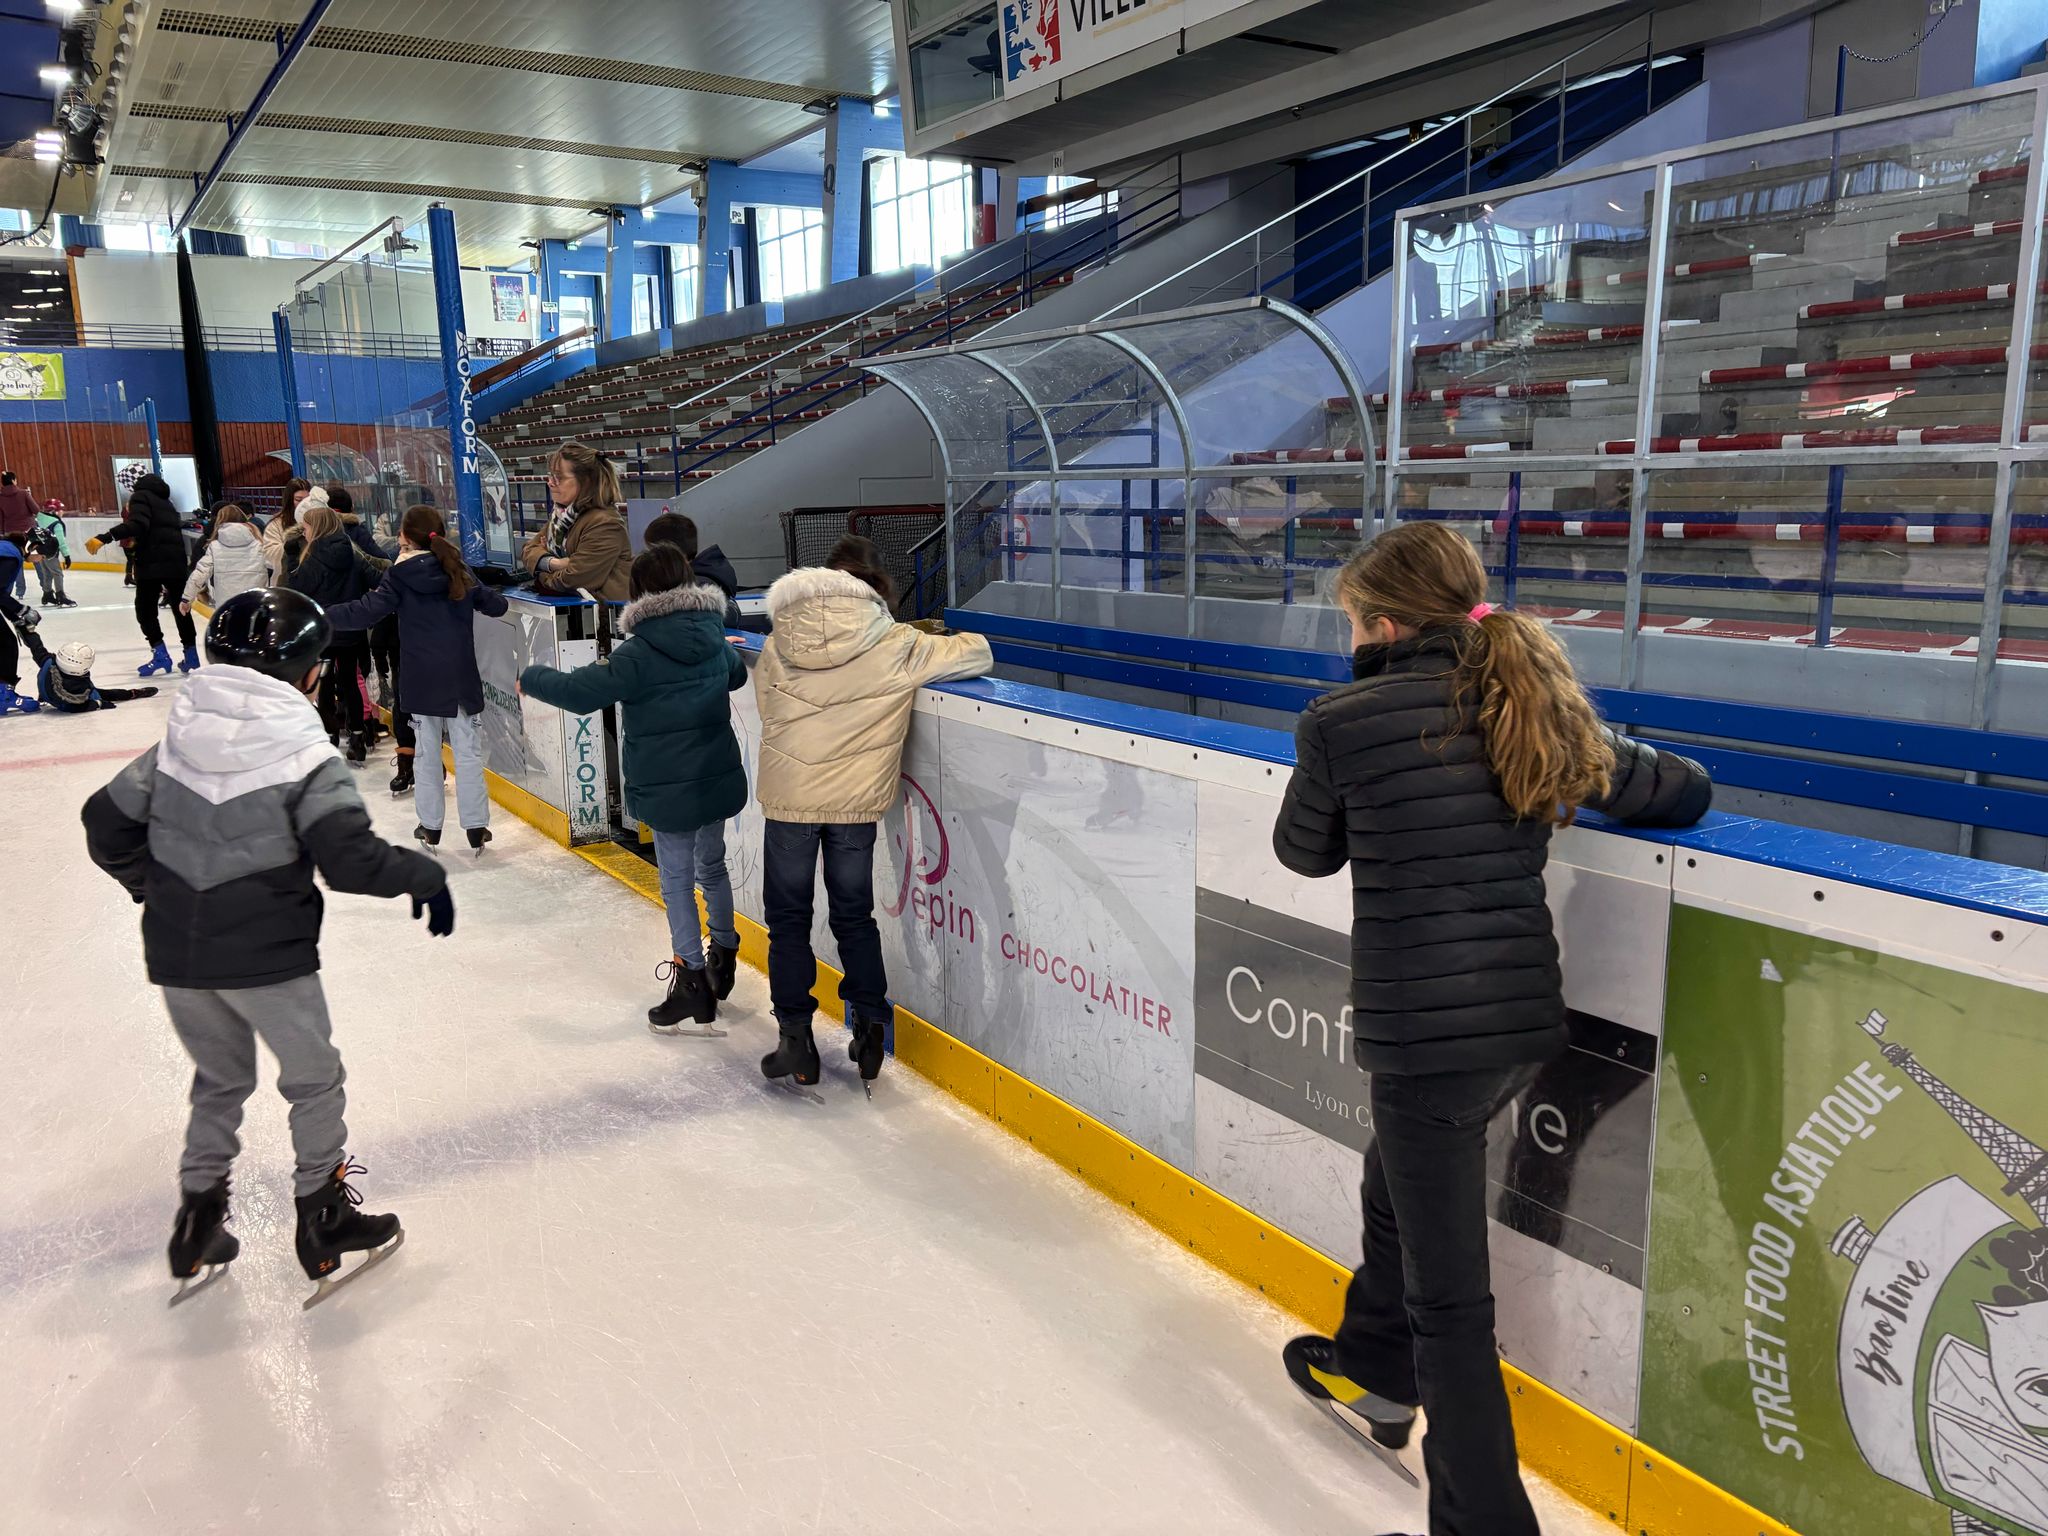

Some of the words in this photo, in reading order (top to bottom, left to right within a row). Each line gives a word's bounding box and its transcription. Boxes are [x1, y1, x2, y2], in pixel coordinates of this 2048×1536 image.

[1000, 933, 1172, 1037] CHOCOLATIER
[1305, 1080, 1350, 1119] Lyon
[1763, 1060, 1904, 1228] ASIATIQUE
[1744, 1221, 1796, 1322] FOOD
[1745, 1319, 1804, 1461] STREET
